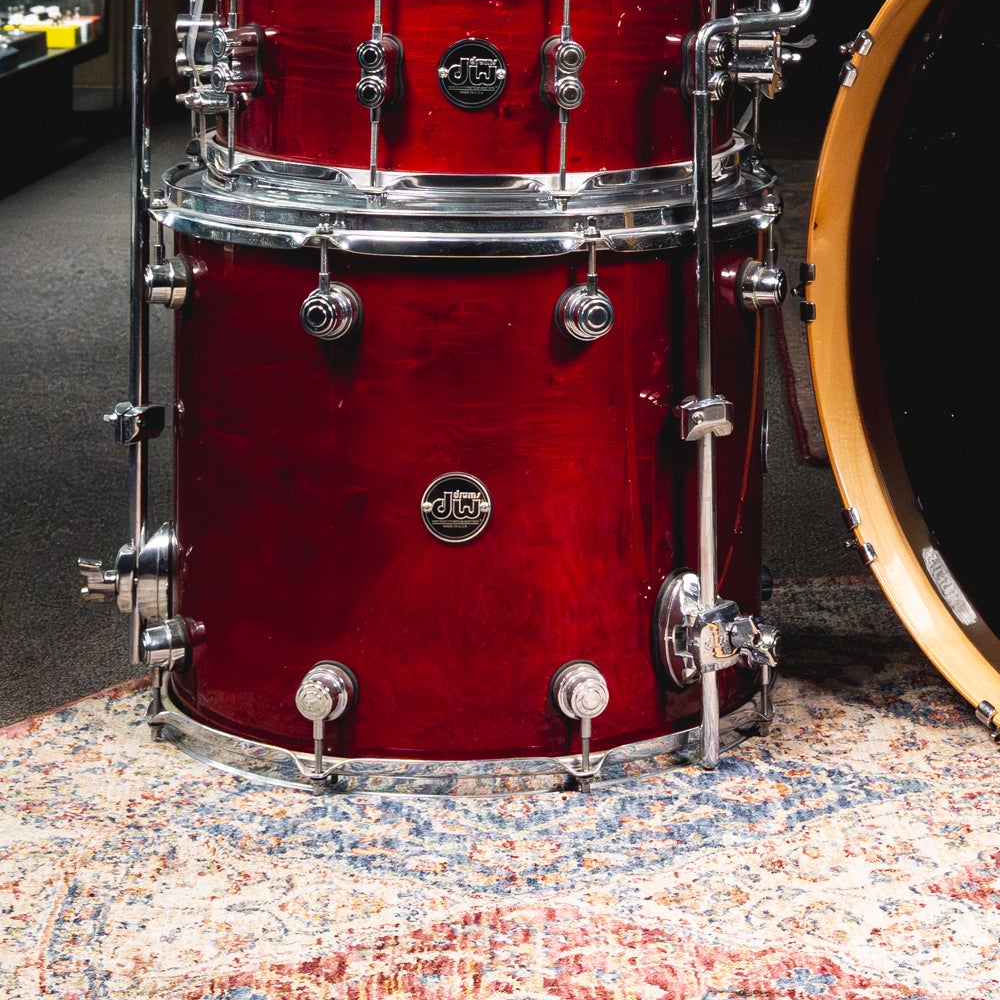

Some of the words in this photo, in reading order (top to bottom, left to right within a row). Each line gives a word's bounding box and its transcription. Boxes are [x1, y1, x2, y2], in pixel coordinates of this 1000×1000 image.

[448, 57, 497, 86] dw
[432, 491, 480, 519] dw
[453, 490, 481, 499] drums
